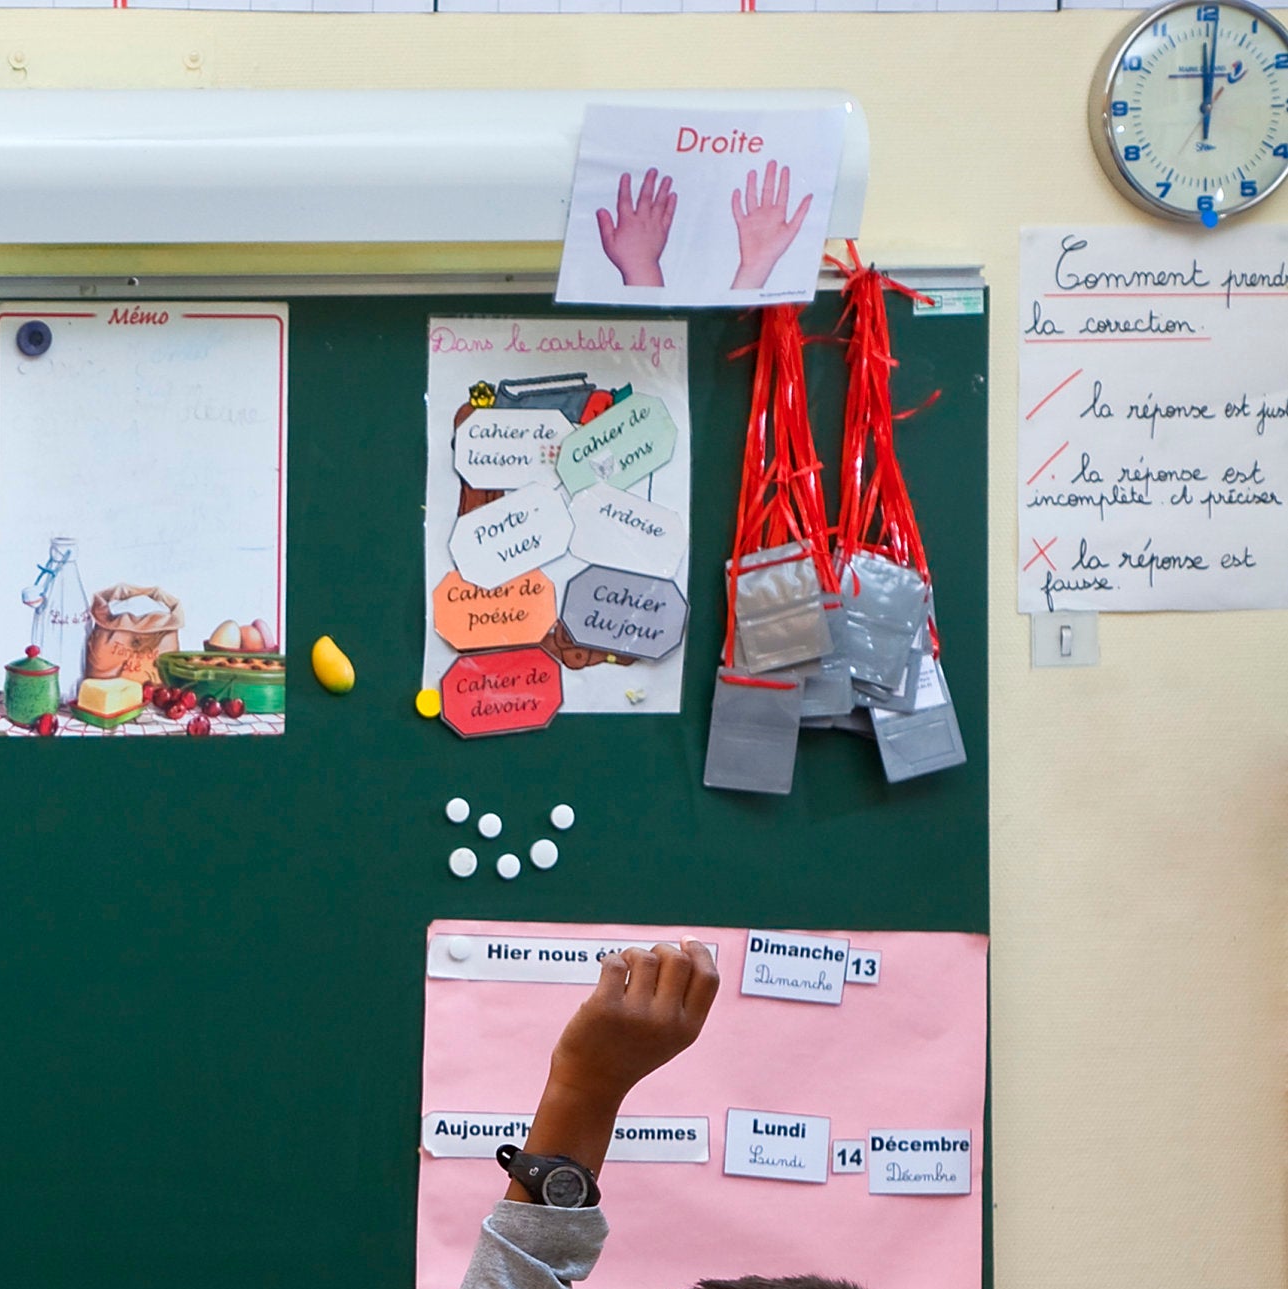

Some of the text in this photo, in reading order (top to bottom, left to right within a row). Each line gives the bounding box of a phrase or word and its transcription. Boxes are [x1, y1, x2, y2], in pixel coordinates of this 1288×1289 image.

[1153, 22, 1167, 37] 11
[1252, 19, 1259, 34] 1
[1111, 100, 1129, 117] 9
[675, 126, 765, 154] Droite
[1124, 145, 1141, 162] 8
[1155, 181, 1172, 199] 7
[1240, 180, 1258, 197] 5
[1197, 195, 1214, 212] 6
[1055, 234, 1211, 290] Comment
[108, 306, 170, 326] Mémo
[1024, 300, 1065, 335] la
[429, 326, 494, 353] Dans
[504, 323, 532, 352] le
[536, 326, 623, 353] cartable
[629, 327, 646, 352] il
[1080, 380, 1114, 418] la
[1126, 392, 1216, 439] réponse
[1224, 393, 1251, 418] est
[468, 424, 556, 440] Cahier de
[572, 406, 652, 463] Cahier de
[468, 452, 534, 467] liaison
[618, 441, 656, 471] sons
[1071, 452, 1266, 497] la réponse est
[598, 502, 667, 538] Ardoise
[496, 534, 543, 563] vues
[1071, 537, 1258, 588] la réponse est
[447, 578, 547, 603] Cahier de
[593, 585, 669, 613] Cahier
[468, 608, 531, 630] poésie
[584, 610, 666, 641] du jour
[456, 669, 553, 695] Cahier de
[471, 698, 542, 718] devoirs
[487, 944, 532, 961] Hier
[538, 947, 588, 963] nous
[749, 937, 845, 963] Dimanche
[754, 964, 833, 991] Dimanche
[851, 958, 876, 976] 13
[614, 1126, 697, 1141] sommes
[752, 1119, 807, 1139] Lundi
[871, 1136, 970, 1153] Décembre
[749, 1145, 806, 1169] Lundi
[837, 1149, 863, 1167] 14
[886, 1162, 957, 1183] Décembre
